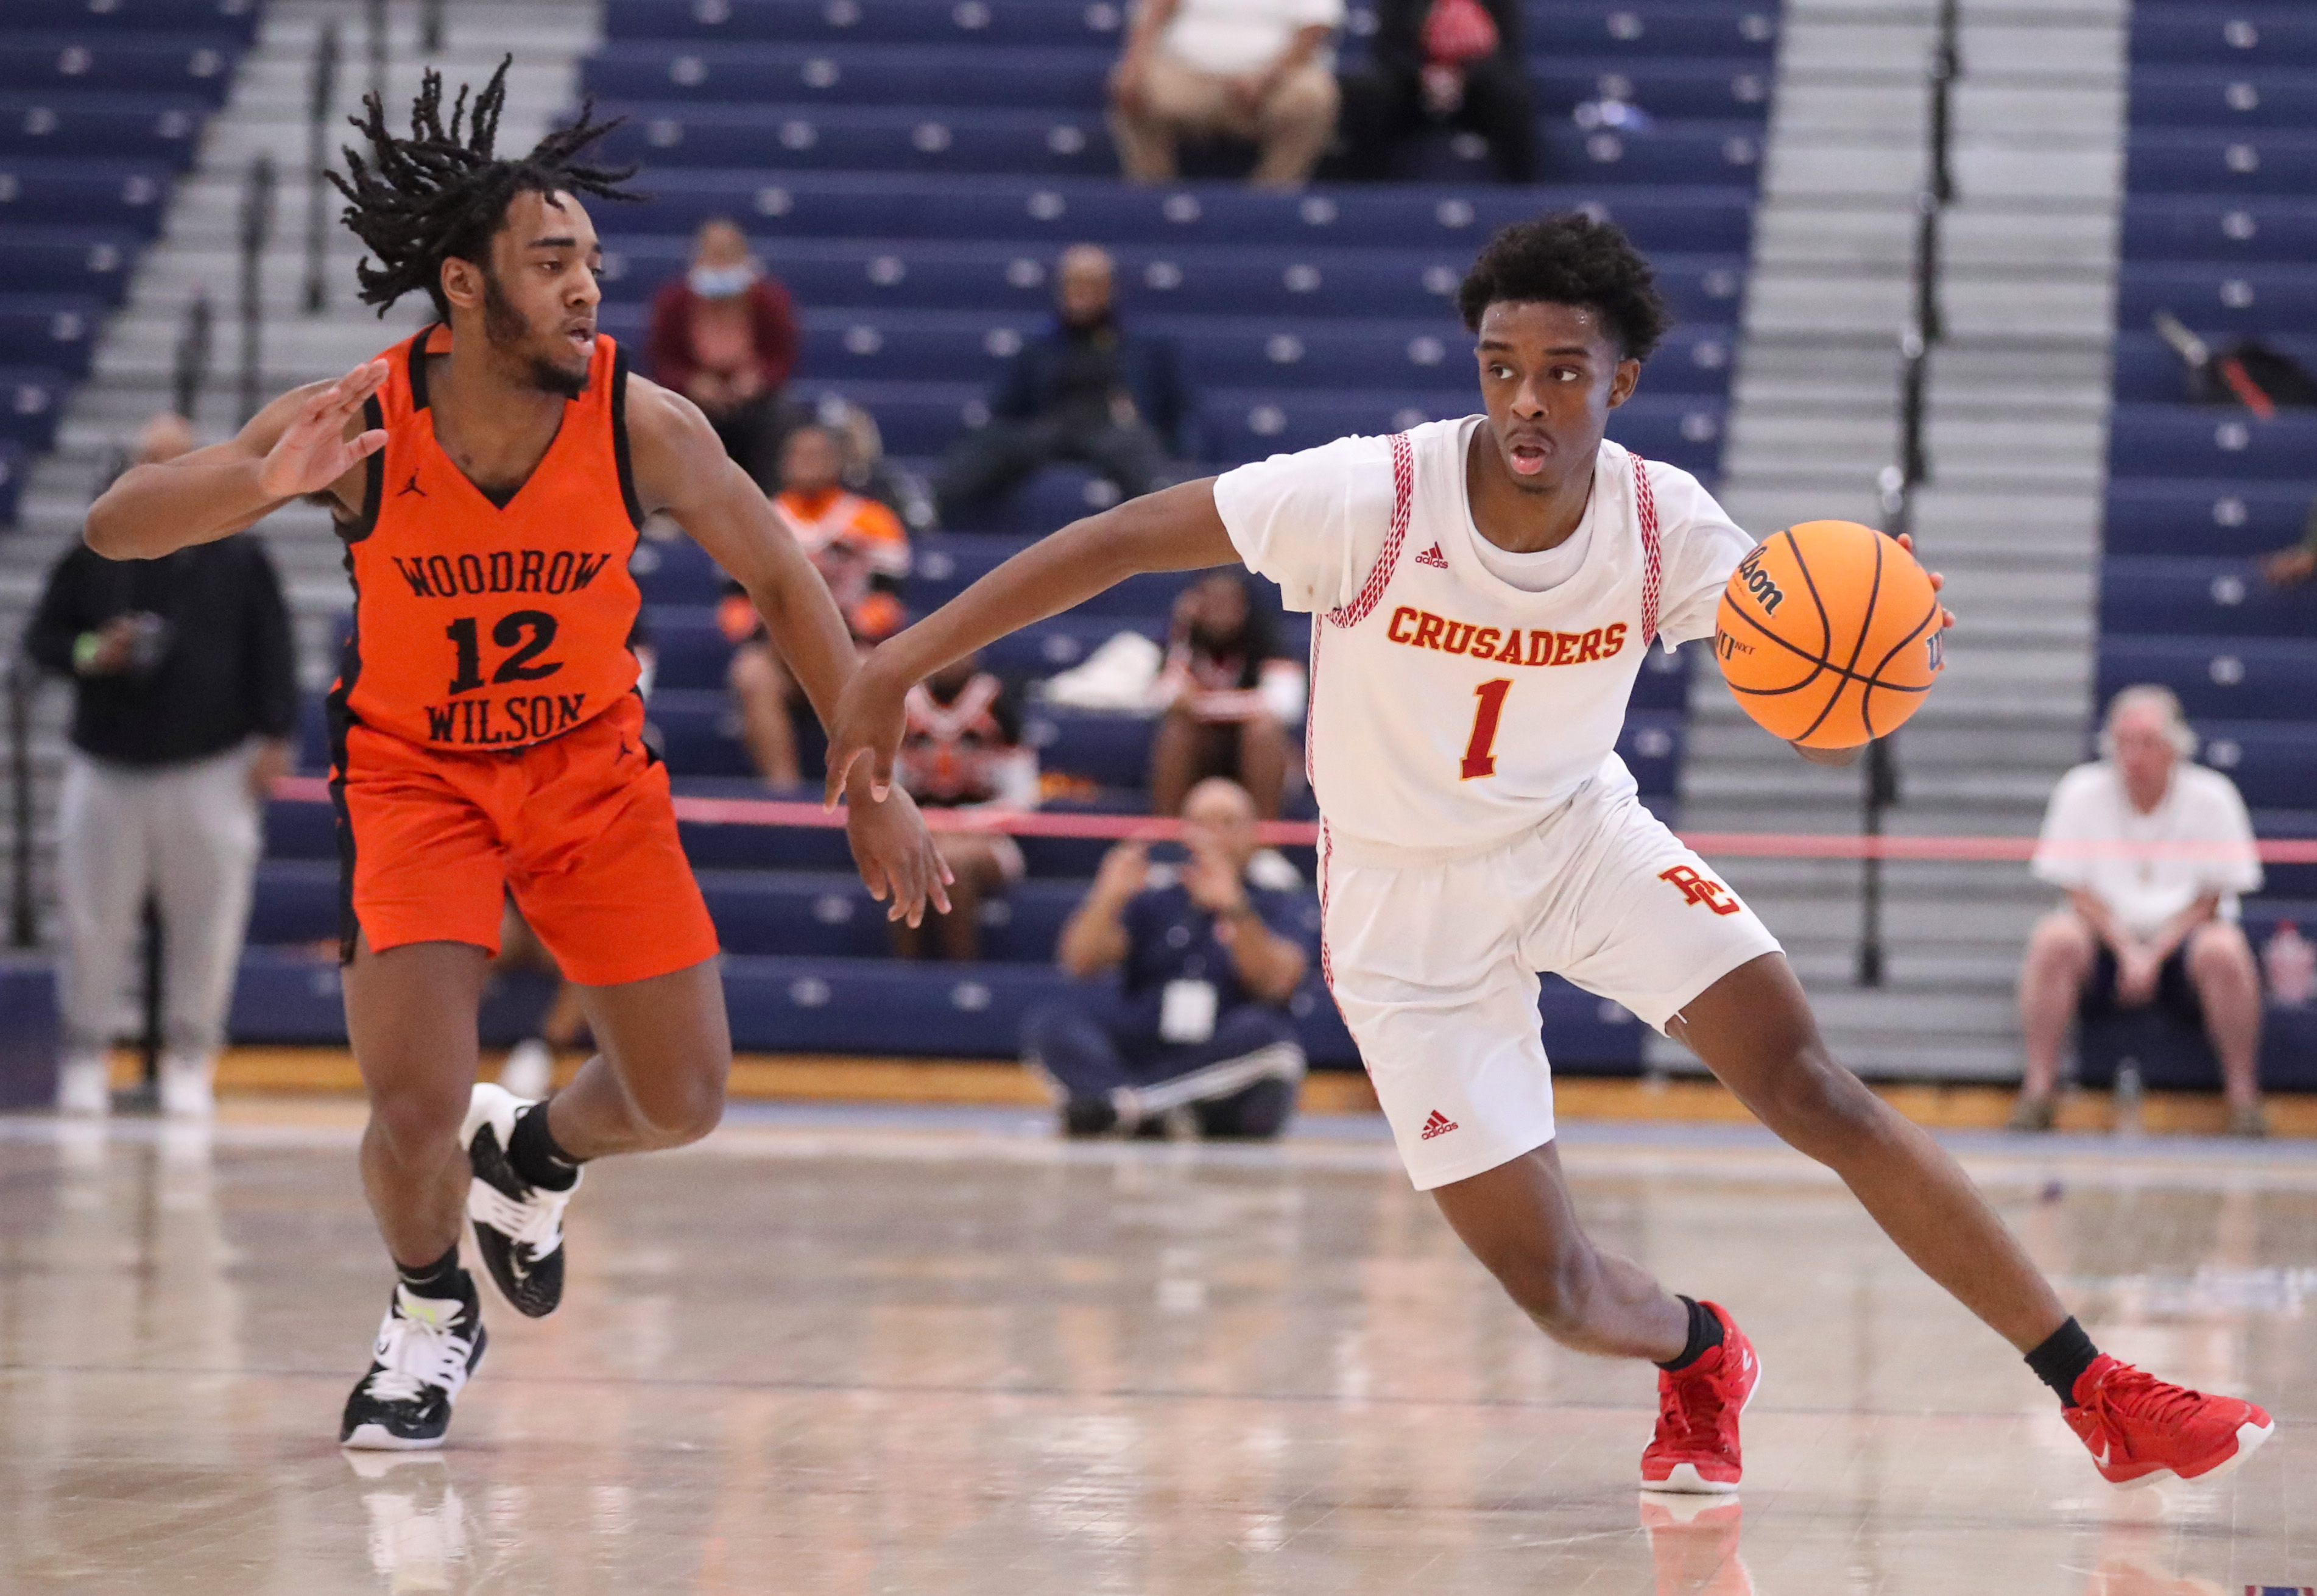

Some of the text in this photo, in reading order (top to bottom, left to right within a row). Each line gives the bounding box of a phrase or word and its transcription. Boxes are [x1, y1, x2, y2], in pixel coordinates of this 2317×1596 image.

[392, 550, 610, 597] WOODROW
[1415, 556, 1448, 569] adidas
[1737, 545, 1783, 615] lson
[446, 610, 563, 695] 12
[1386, 606, 1628, 666] CRUSADERS
[1735, 641, 1756, 655] NXT
[425, 693, 585, 744] WILSON
[1459, 677, 1514, 781] 1
[1421, 1122, 1459, 1140] adidas
